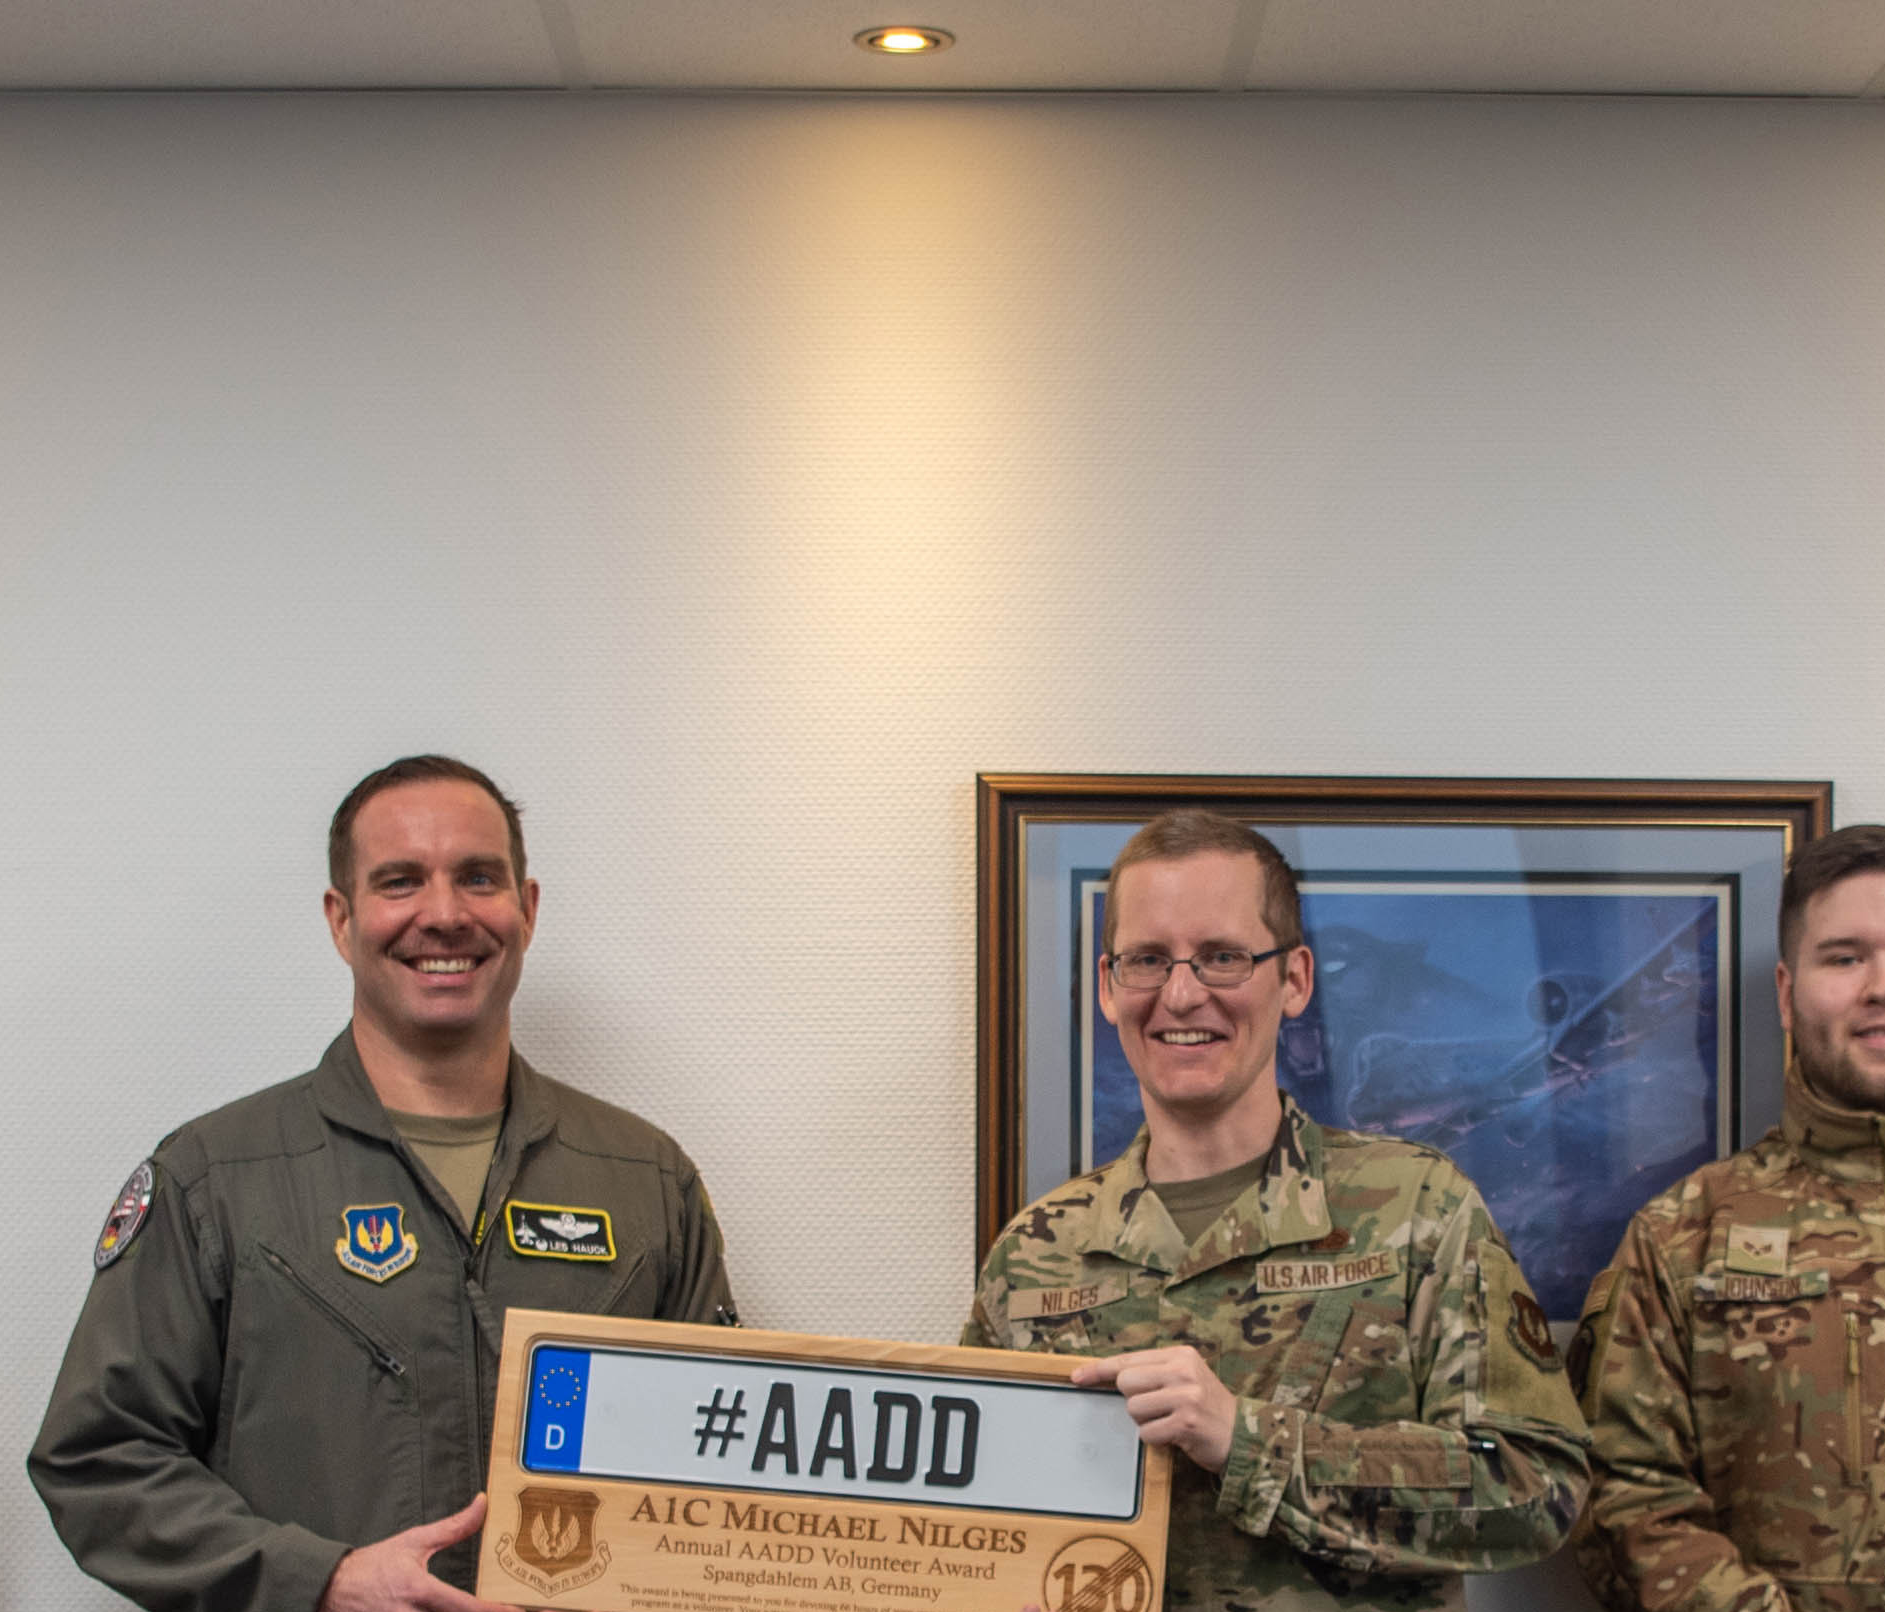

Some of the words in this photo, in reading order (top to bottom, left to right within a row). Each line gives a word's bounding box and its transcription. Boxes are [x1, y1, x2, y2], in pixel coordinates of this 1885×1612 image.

[1299, 1264, 1329, 1287] AIR
[1332, 1252, 1390, 1283] FORCE
[1041, 1285, 1099, 1314] NILGES
[1718, 1276, 1801, 1299] JOHNSON
[544, 1424, 566, 1450] D
[694, 1381, 982, 1489] #AADD
[629, 1493, 711, 1527] A1C
[653, 1533, 731, 1558] Annual
[737, 1541, 815, 1565] AADD
[820, 1546, 920, 1574] Volunteer
[926, 1559, 997, 1581] Award
[620, 1583, 639, 1594] This
[642, 1586, 668, 1597] award
[681, 1589, 706, 1601] being
[763, 1597, 781, 1607] you
[703, 1564, 818, 1590] Spangdahlem
[823, 1575, 855, 1596] AB,
[861, 1578, 942, 1603] Germany
[631, 1598, 669, 1609] program
